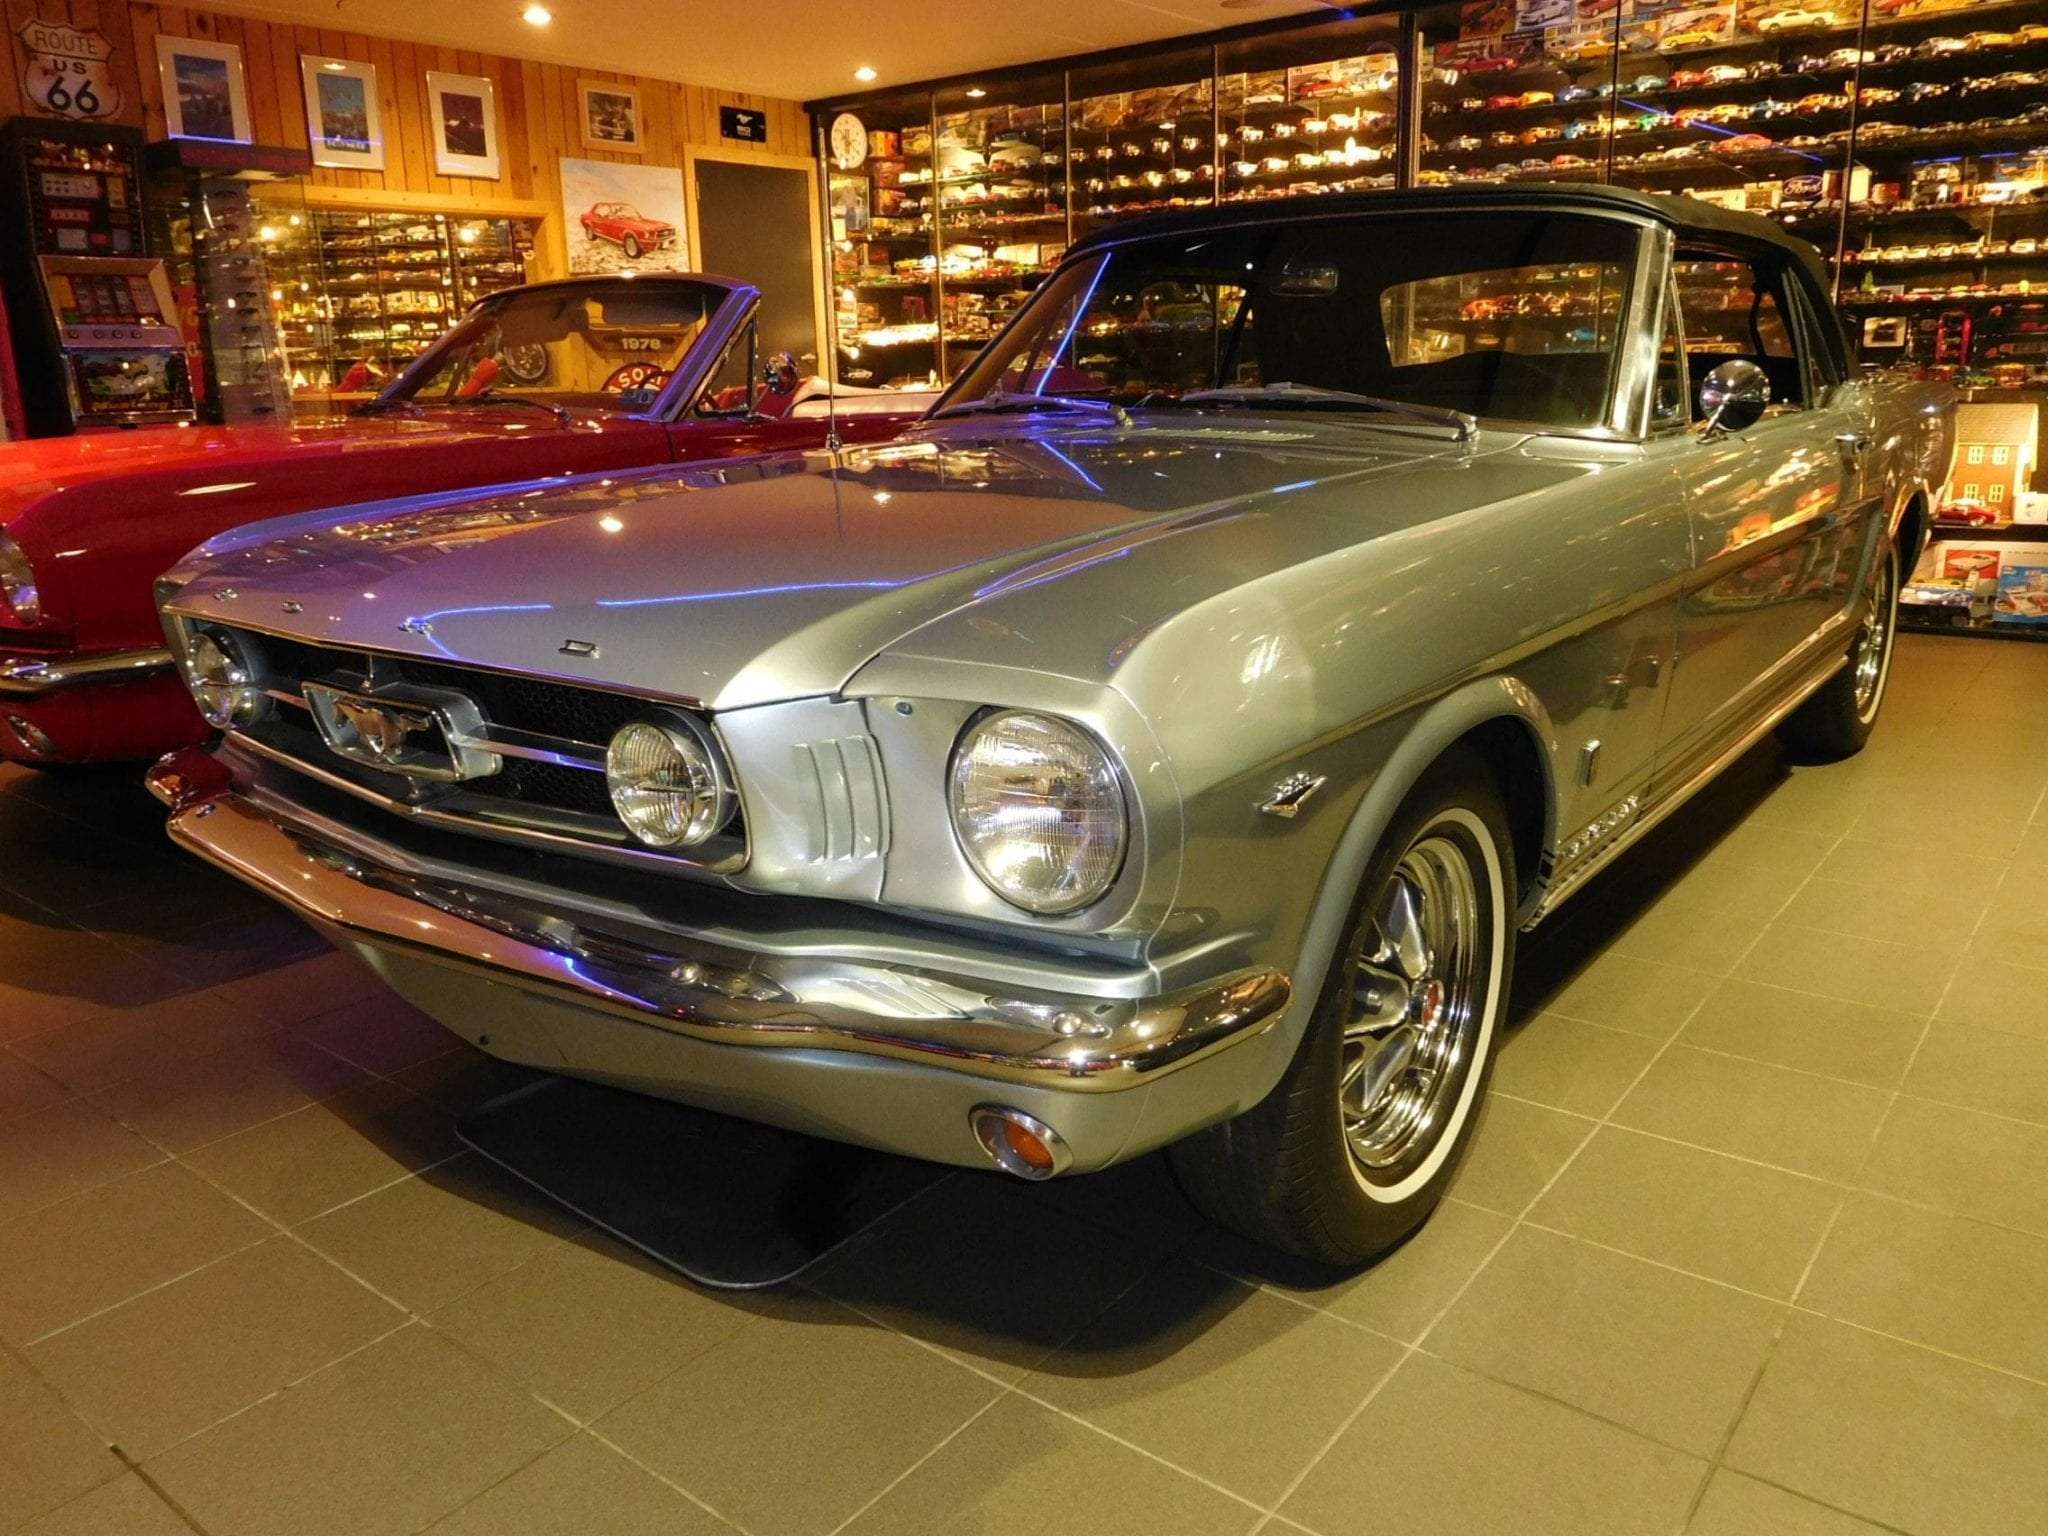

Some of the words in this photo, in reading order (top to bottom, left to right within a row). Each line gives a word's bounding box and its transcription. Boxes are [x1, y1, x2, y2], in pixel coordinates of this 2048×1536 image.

[34, 30, 98, 55] ROUTE
[53, 59, 87, 75] US
[47, 76, 100, 114] 66
[1784, 179, 1822, 195] Ford
